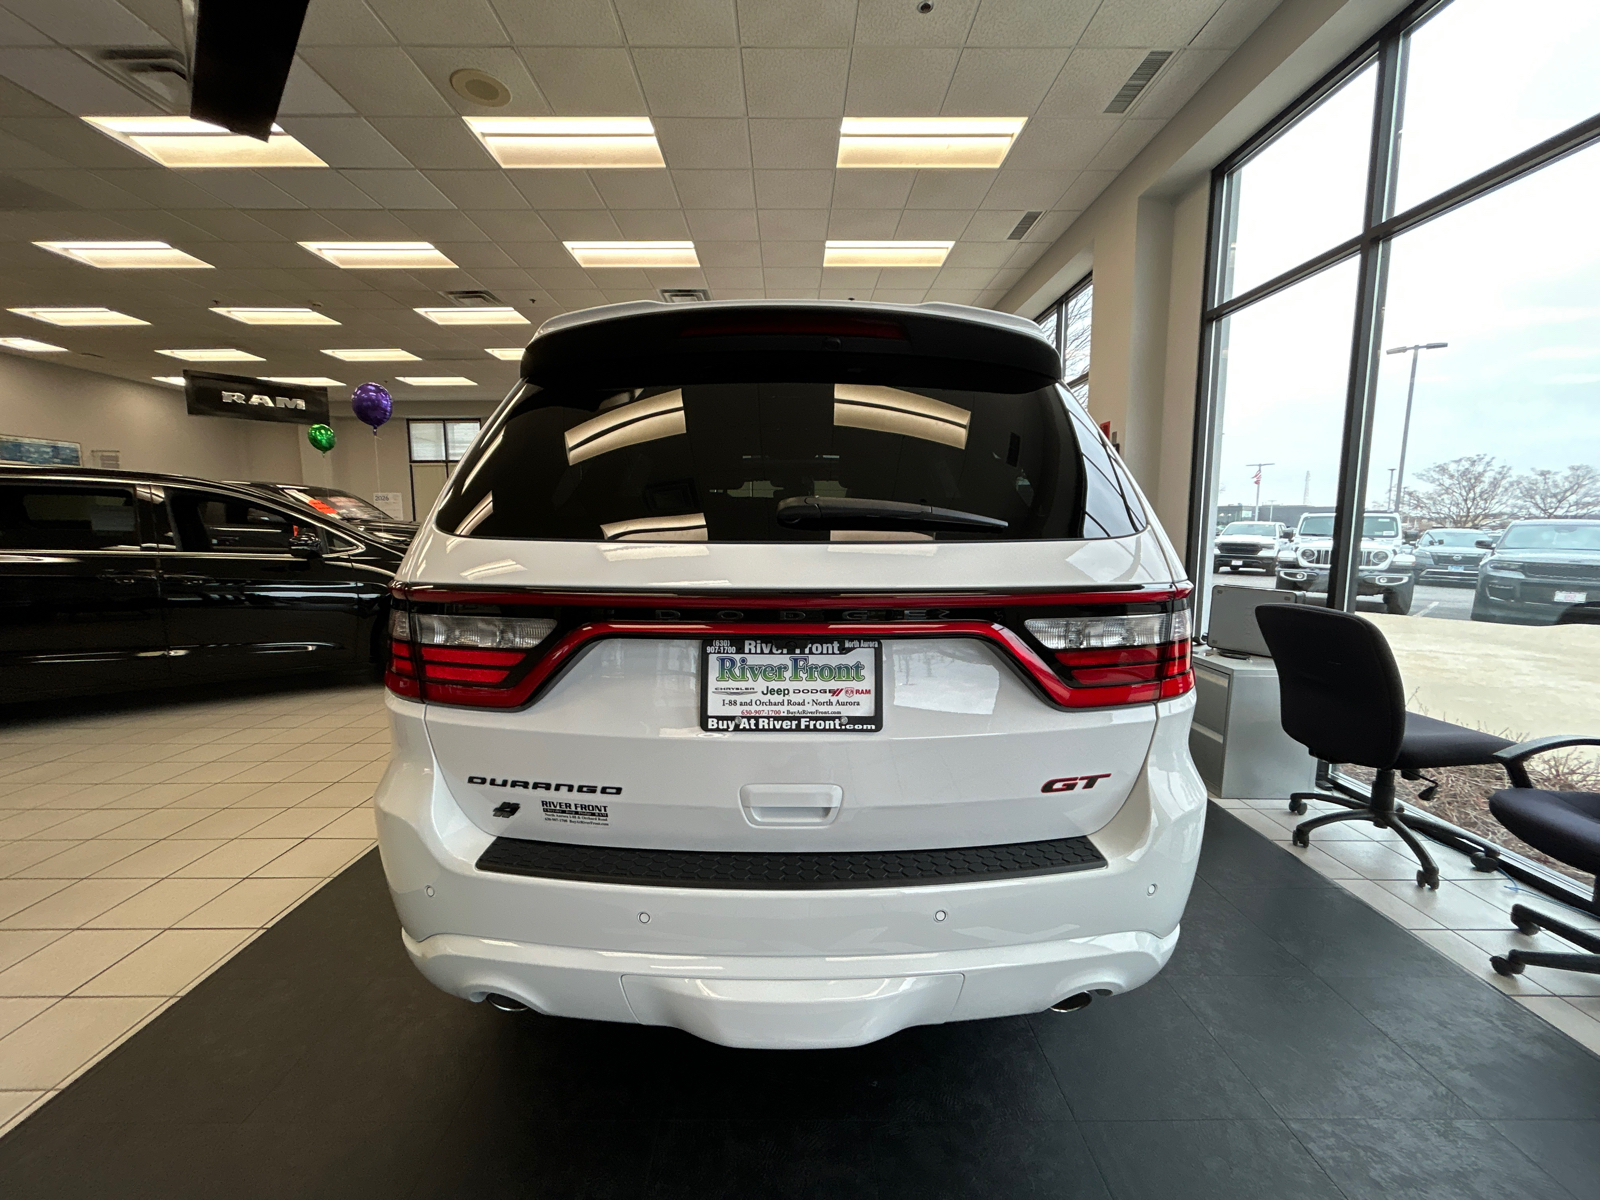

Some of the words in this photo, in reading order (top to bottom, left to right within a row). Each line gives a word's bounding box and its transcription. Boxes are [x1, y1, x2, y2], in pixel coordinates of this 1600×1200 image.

[221, 390, 306, 410] RAM
[706, 646, 737, 654] 907-1700
[844, 639, 860, 648] North
[860, 639, 879, 648] Aurora
[716, 656, 789, 682] River
[789, 656, 866, 682] Front
[761, 686, 790, 697] Jeep
[722, 699, 738, 707] I-88
[739, 699, 753, 707] and
[754, 699, 785, 707] Orchard
[786, 699, 806, 707] Road
[811, 699, 834, 707] North
[835, 699, 860, 707] Aurora
[786, 709, 842, 717] BuyAtRiverFront.com
[707, 718, 736, 731] Buy
[739, 718, 756, 729] At
[758, 718, 799, 729] River
[467, 775, 623, 796] DURANGO
[1041, 773, 1112, 793] GT
[541, 800, 572, 810] RIVER
[574, 803, 609, 813] FRONT
